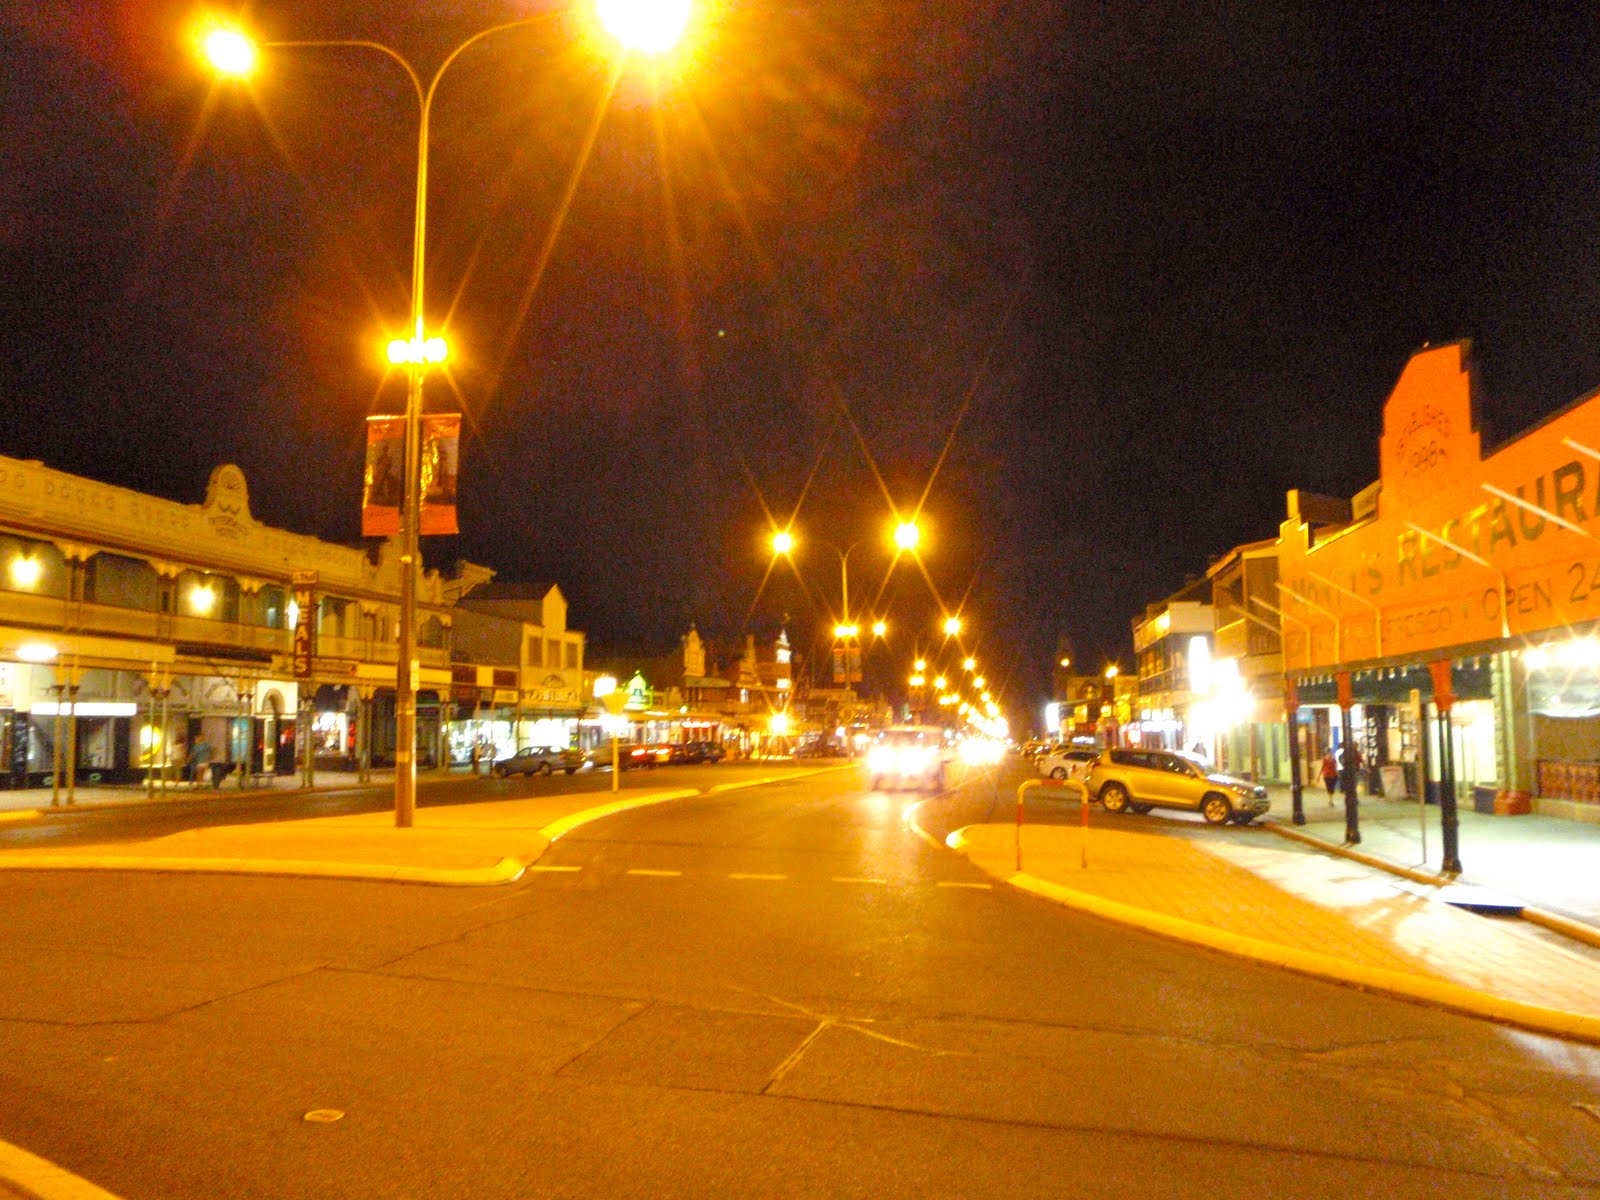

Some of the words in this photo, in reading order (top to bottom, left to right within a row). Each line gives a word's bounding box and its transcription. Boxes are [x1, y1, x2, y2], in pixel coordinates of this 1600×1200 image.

[1397, 459, 1600, 588] RESTAUR
[294, 590, 311, 673] MEALS
[1480, 576, 1553, 622] OPEN
[1367, 716, 1379, 767] SUSHI
